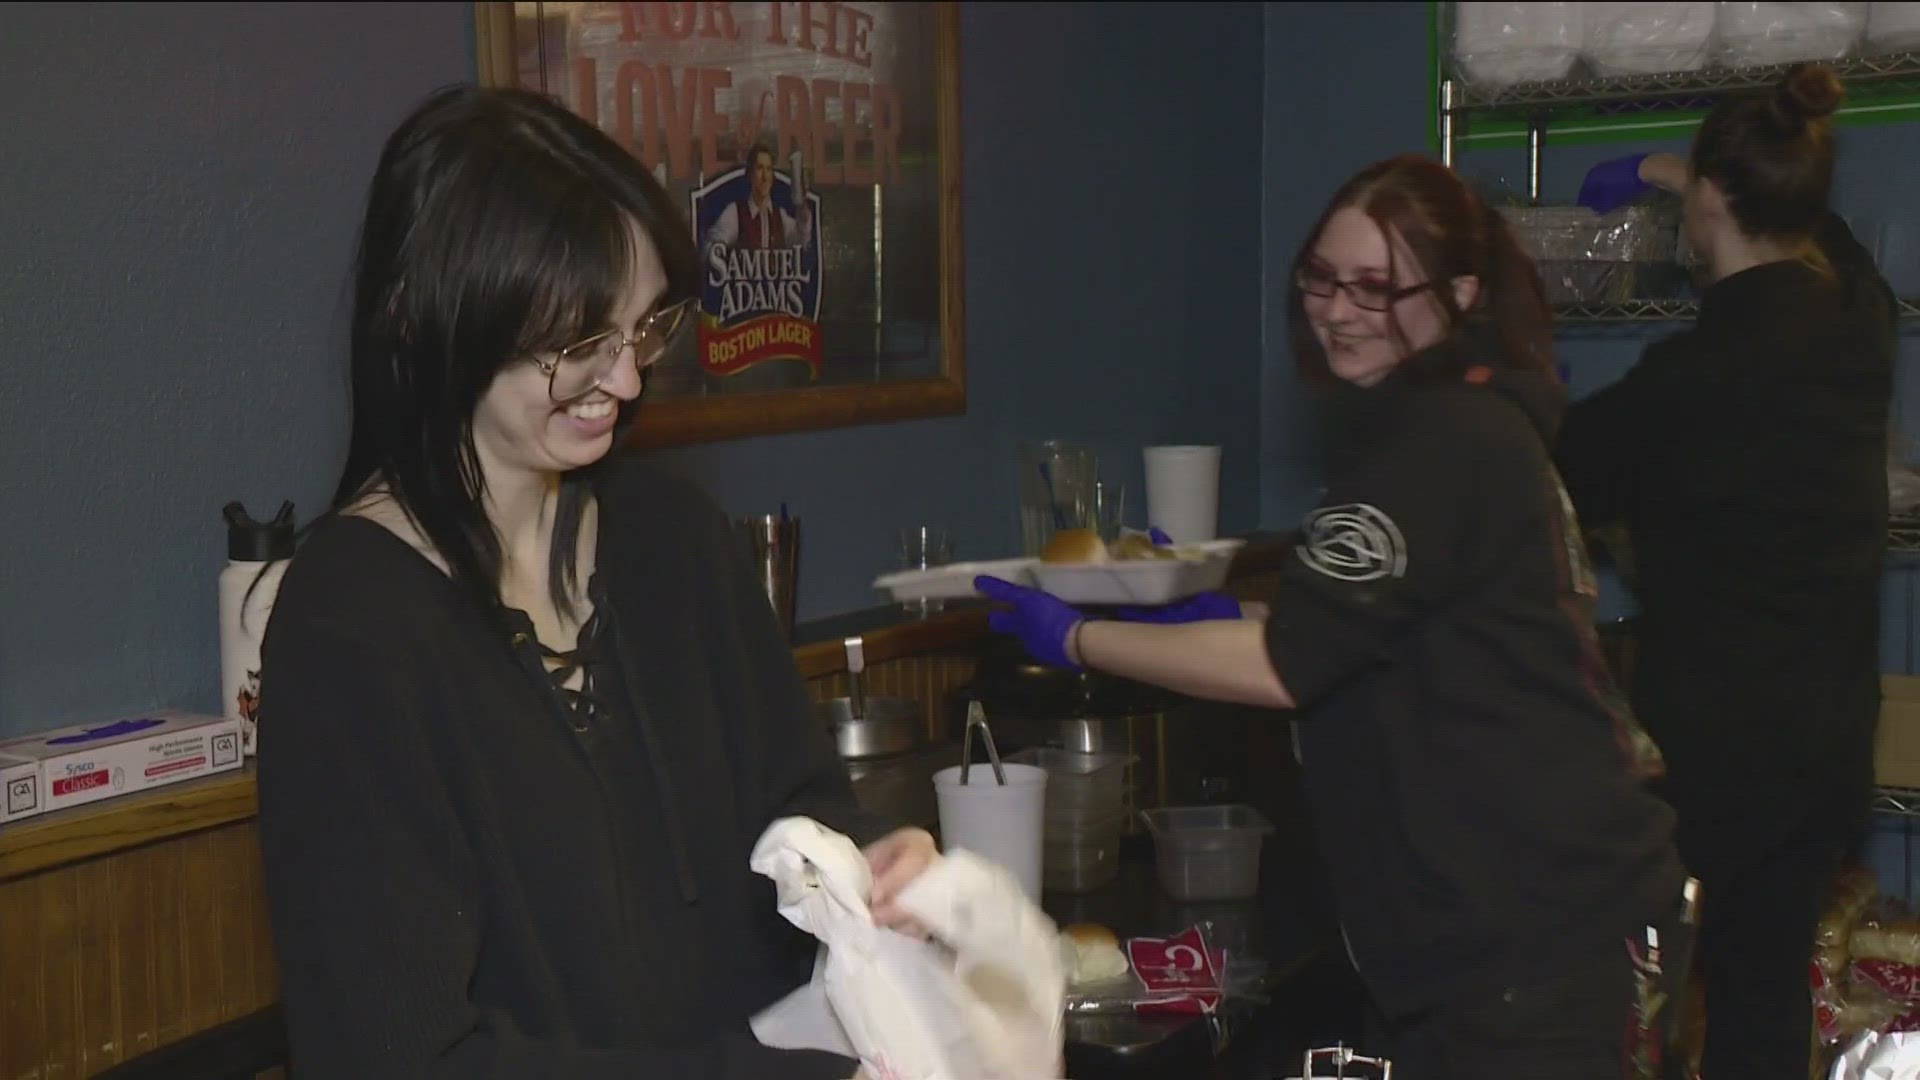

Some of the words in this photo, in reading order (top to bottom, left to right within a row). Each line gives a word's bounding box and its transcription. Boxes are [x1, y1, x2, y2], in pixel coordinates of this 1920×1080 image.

[709, 242, 811, 287] SAMUEL
[719, 279, 805, 323] ADAMS
[708, 326, 766, 365] BOSTON
[768, 321, 812, 349] LAGER
[62, 773, 100, 794] Classic
